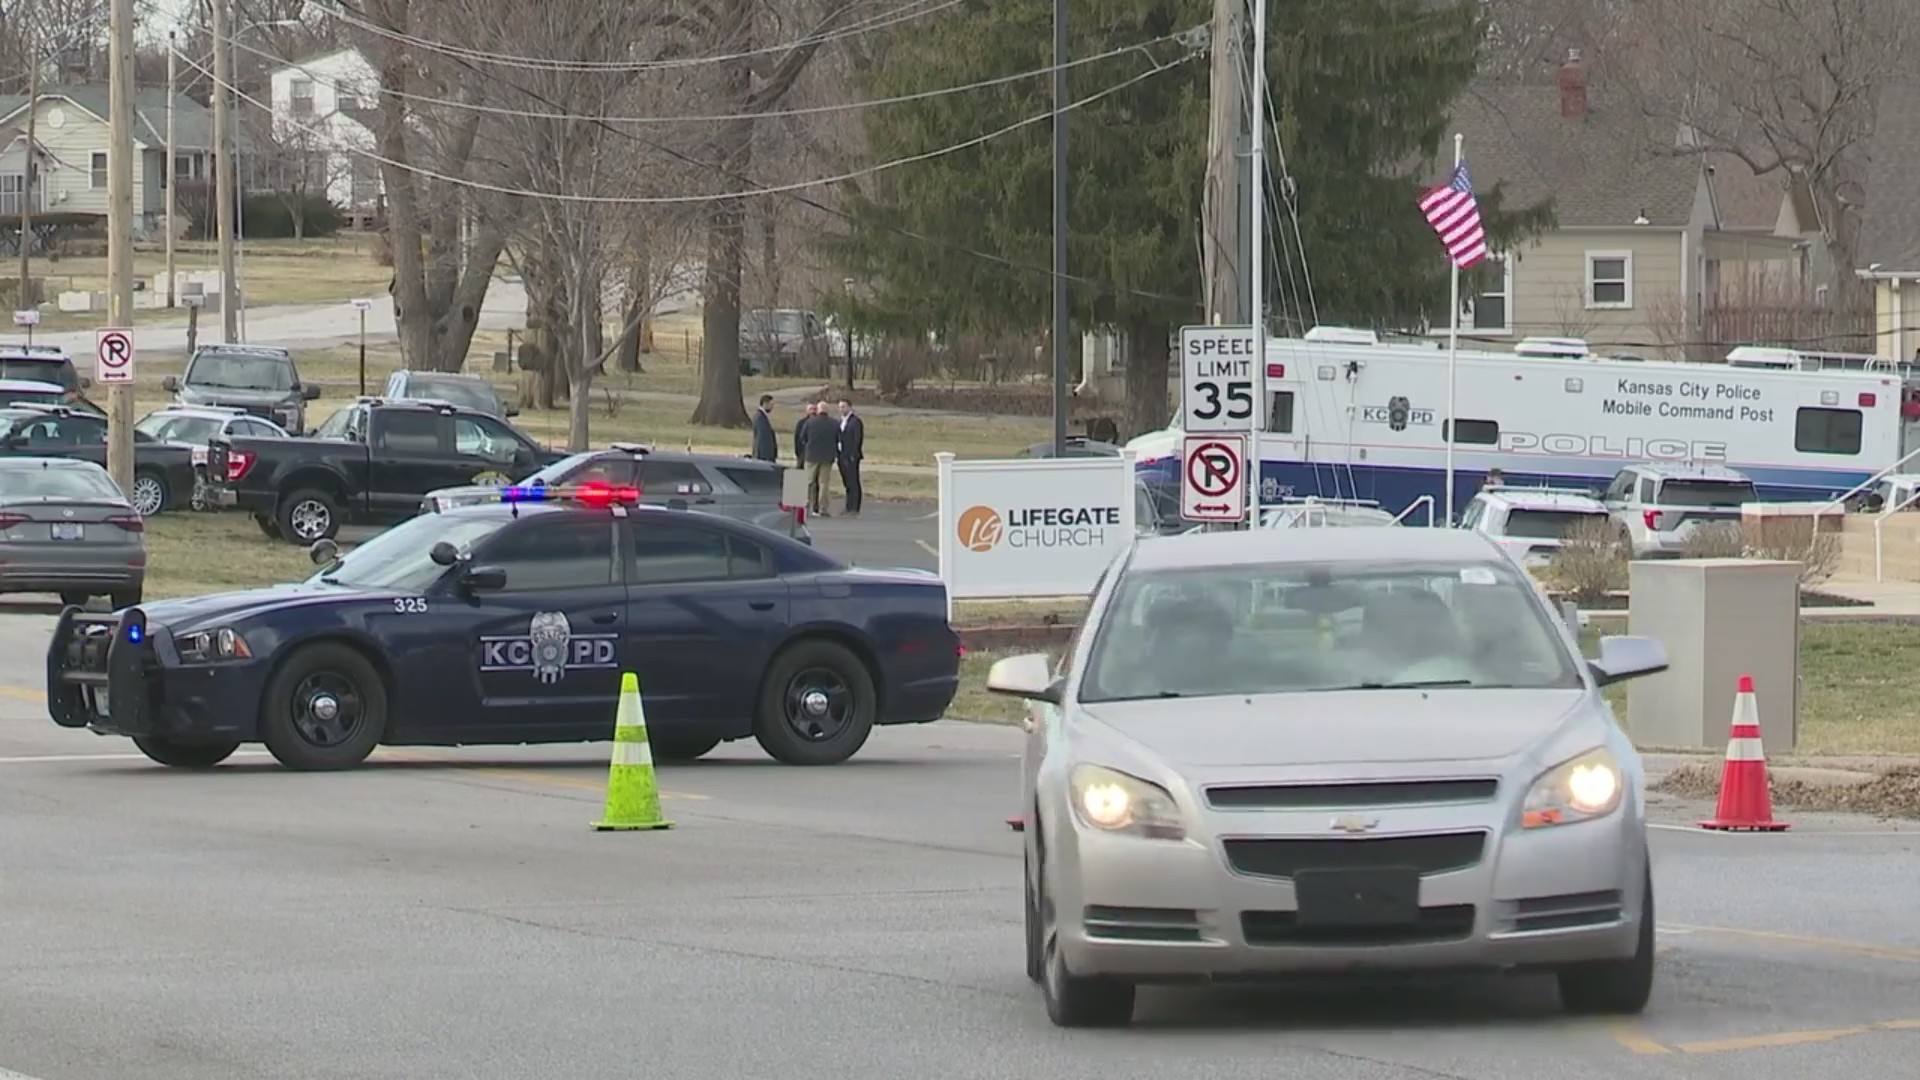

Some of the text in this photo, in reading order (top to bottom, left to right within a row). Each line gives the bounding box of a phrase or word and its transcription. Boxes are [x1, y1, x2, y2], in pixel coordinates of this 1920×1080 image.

[1198, 361, 1250, 377] LIMIT
[1618, 379, 1761, 400] Kansas City Police
[1193, 382, 1253, 419] 35
[1602, 400, 1774, 422] Mobile Command Post
[1498, 432, 1727, 461] POLICE
[1008, 507, 1120, 527] LIFEGATE
[1008, 528, 1104, 548] CHURCH
[394, 598, 428, 613] 325
[484, 640, 615, 665] KC PD
